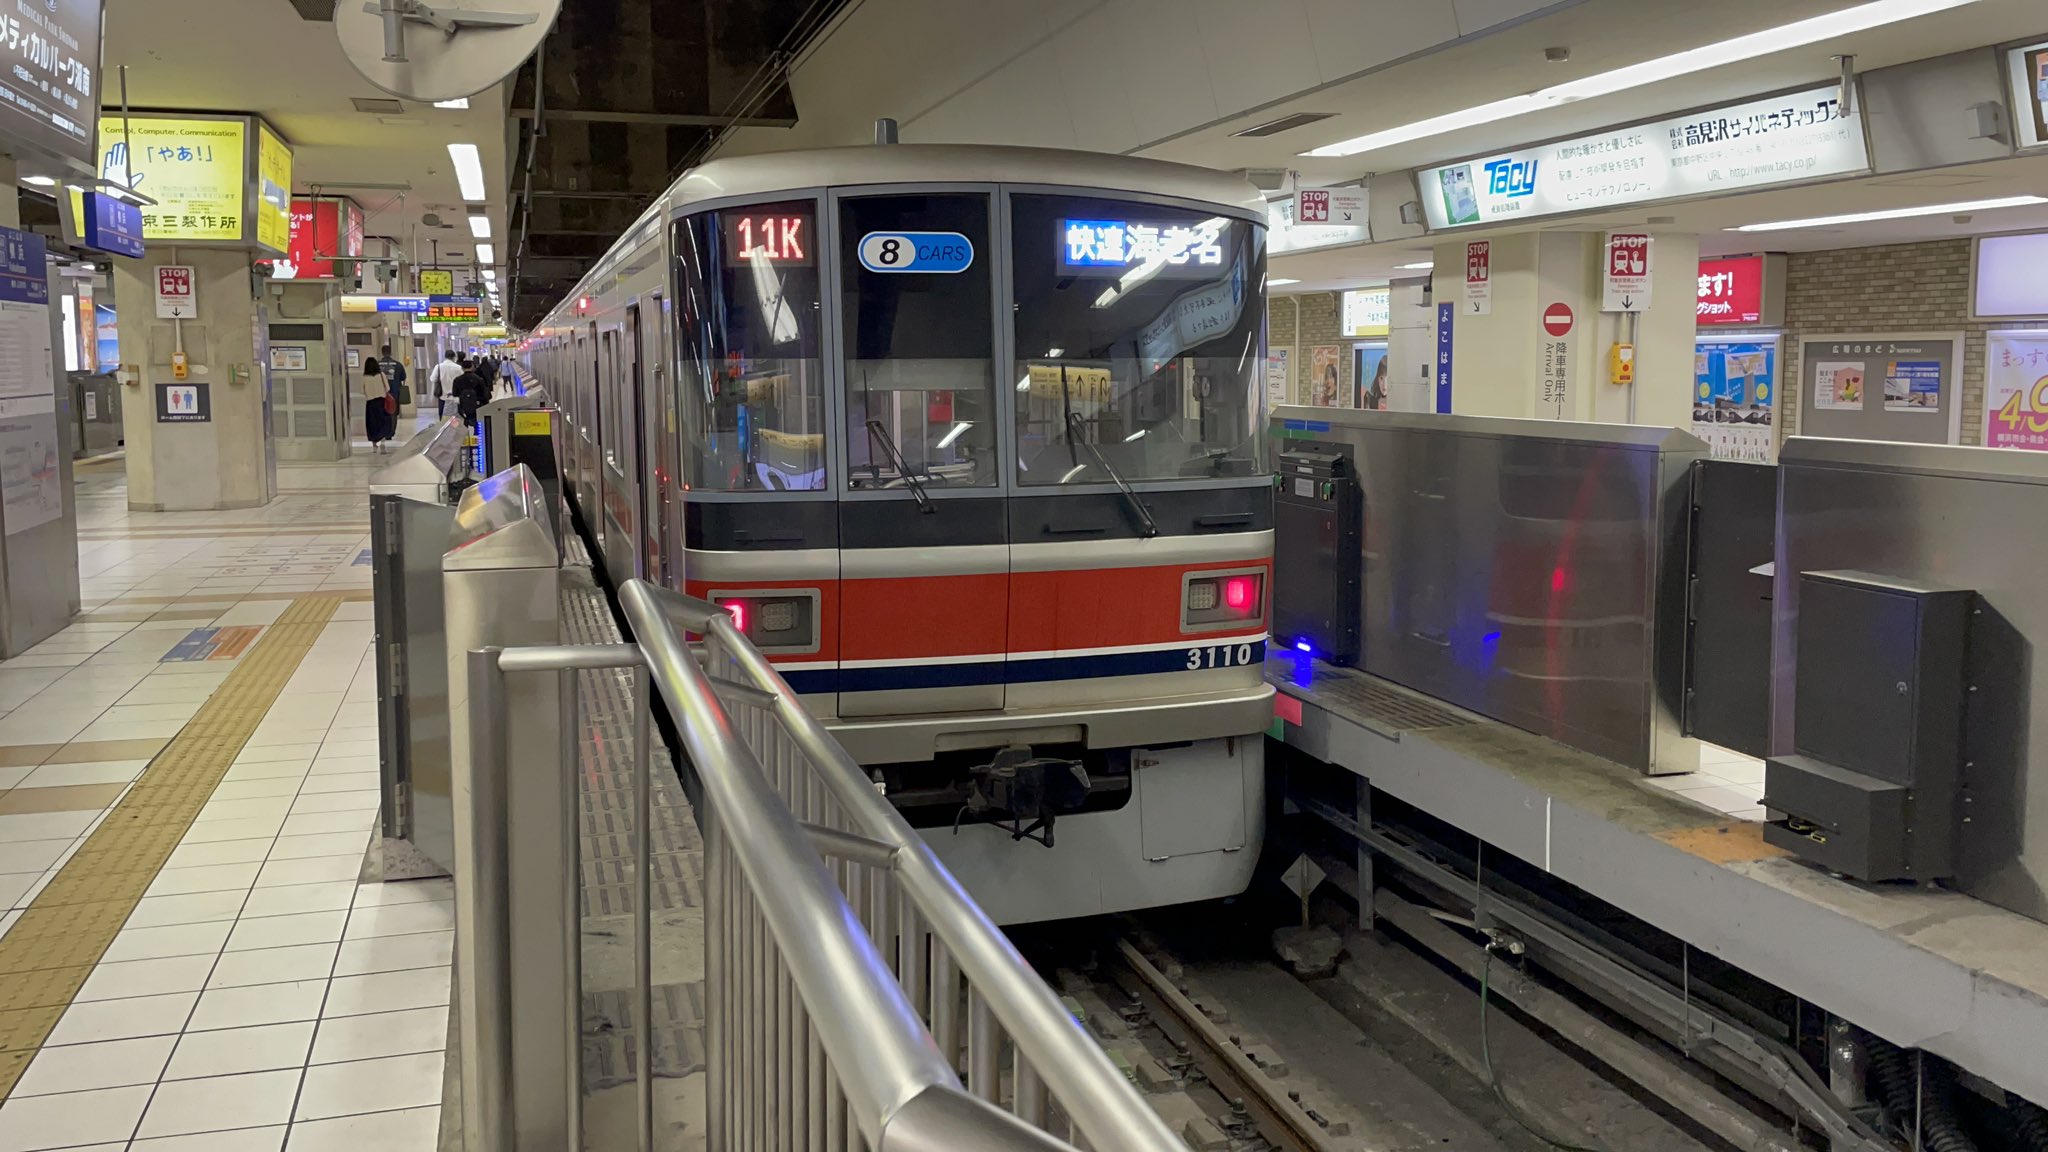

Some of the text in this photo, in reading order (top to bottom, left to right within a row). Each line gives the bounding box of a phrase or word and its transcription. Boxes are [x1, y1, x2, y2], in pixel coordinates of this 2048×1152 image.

[137, 127, 178, 136] Computer,
[179, 128, 237, 138] Communication
[1302, 192, 1329, 202] STOP
[738, 217, 804, 259] 11K
[1067, 225, 1125, 262] 快速
[1468, 244, 1489, 256] STOP
[1612, 236, 1647, 249] STOP
[879, 239, 966, 265] 8 CARS
[160, 268, 188, 278] STOP
[1698, 271, 1733, 297] ます!
[419, 300, 427, 311] 3
[1438, 308, 1449, 386] よこはま
[1543, 342, 1555, 402] Arrival Only
[1553, 341, 1566, 420] 降車専用ホー
[1186, 643, 1252, 670] 3110
